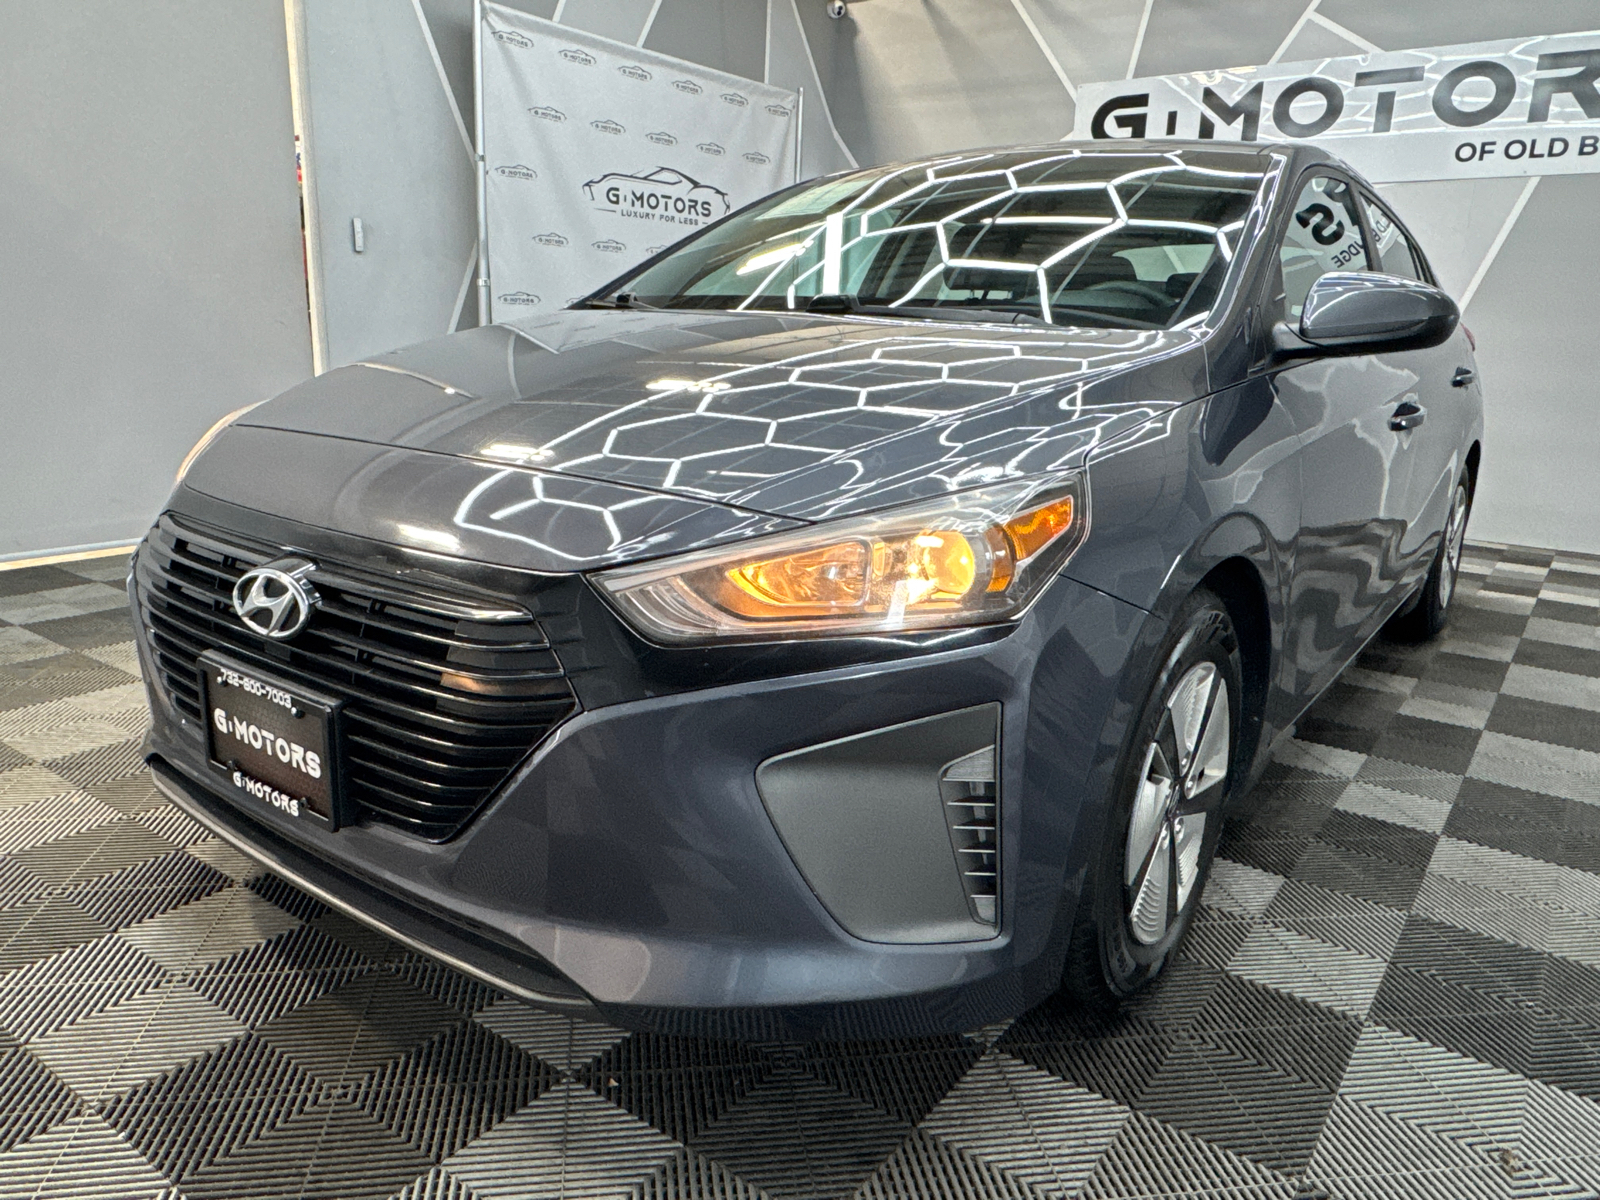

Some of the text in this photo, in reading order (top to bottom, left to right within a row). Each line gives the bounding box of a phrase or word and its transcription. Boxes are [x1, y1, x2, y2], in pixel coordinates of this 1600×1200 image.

[1455, 135, 1600, 162] OF OLD B
[621, 209, 698, 226] LUXURY FOR LESS
